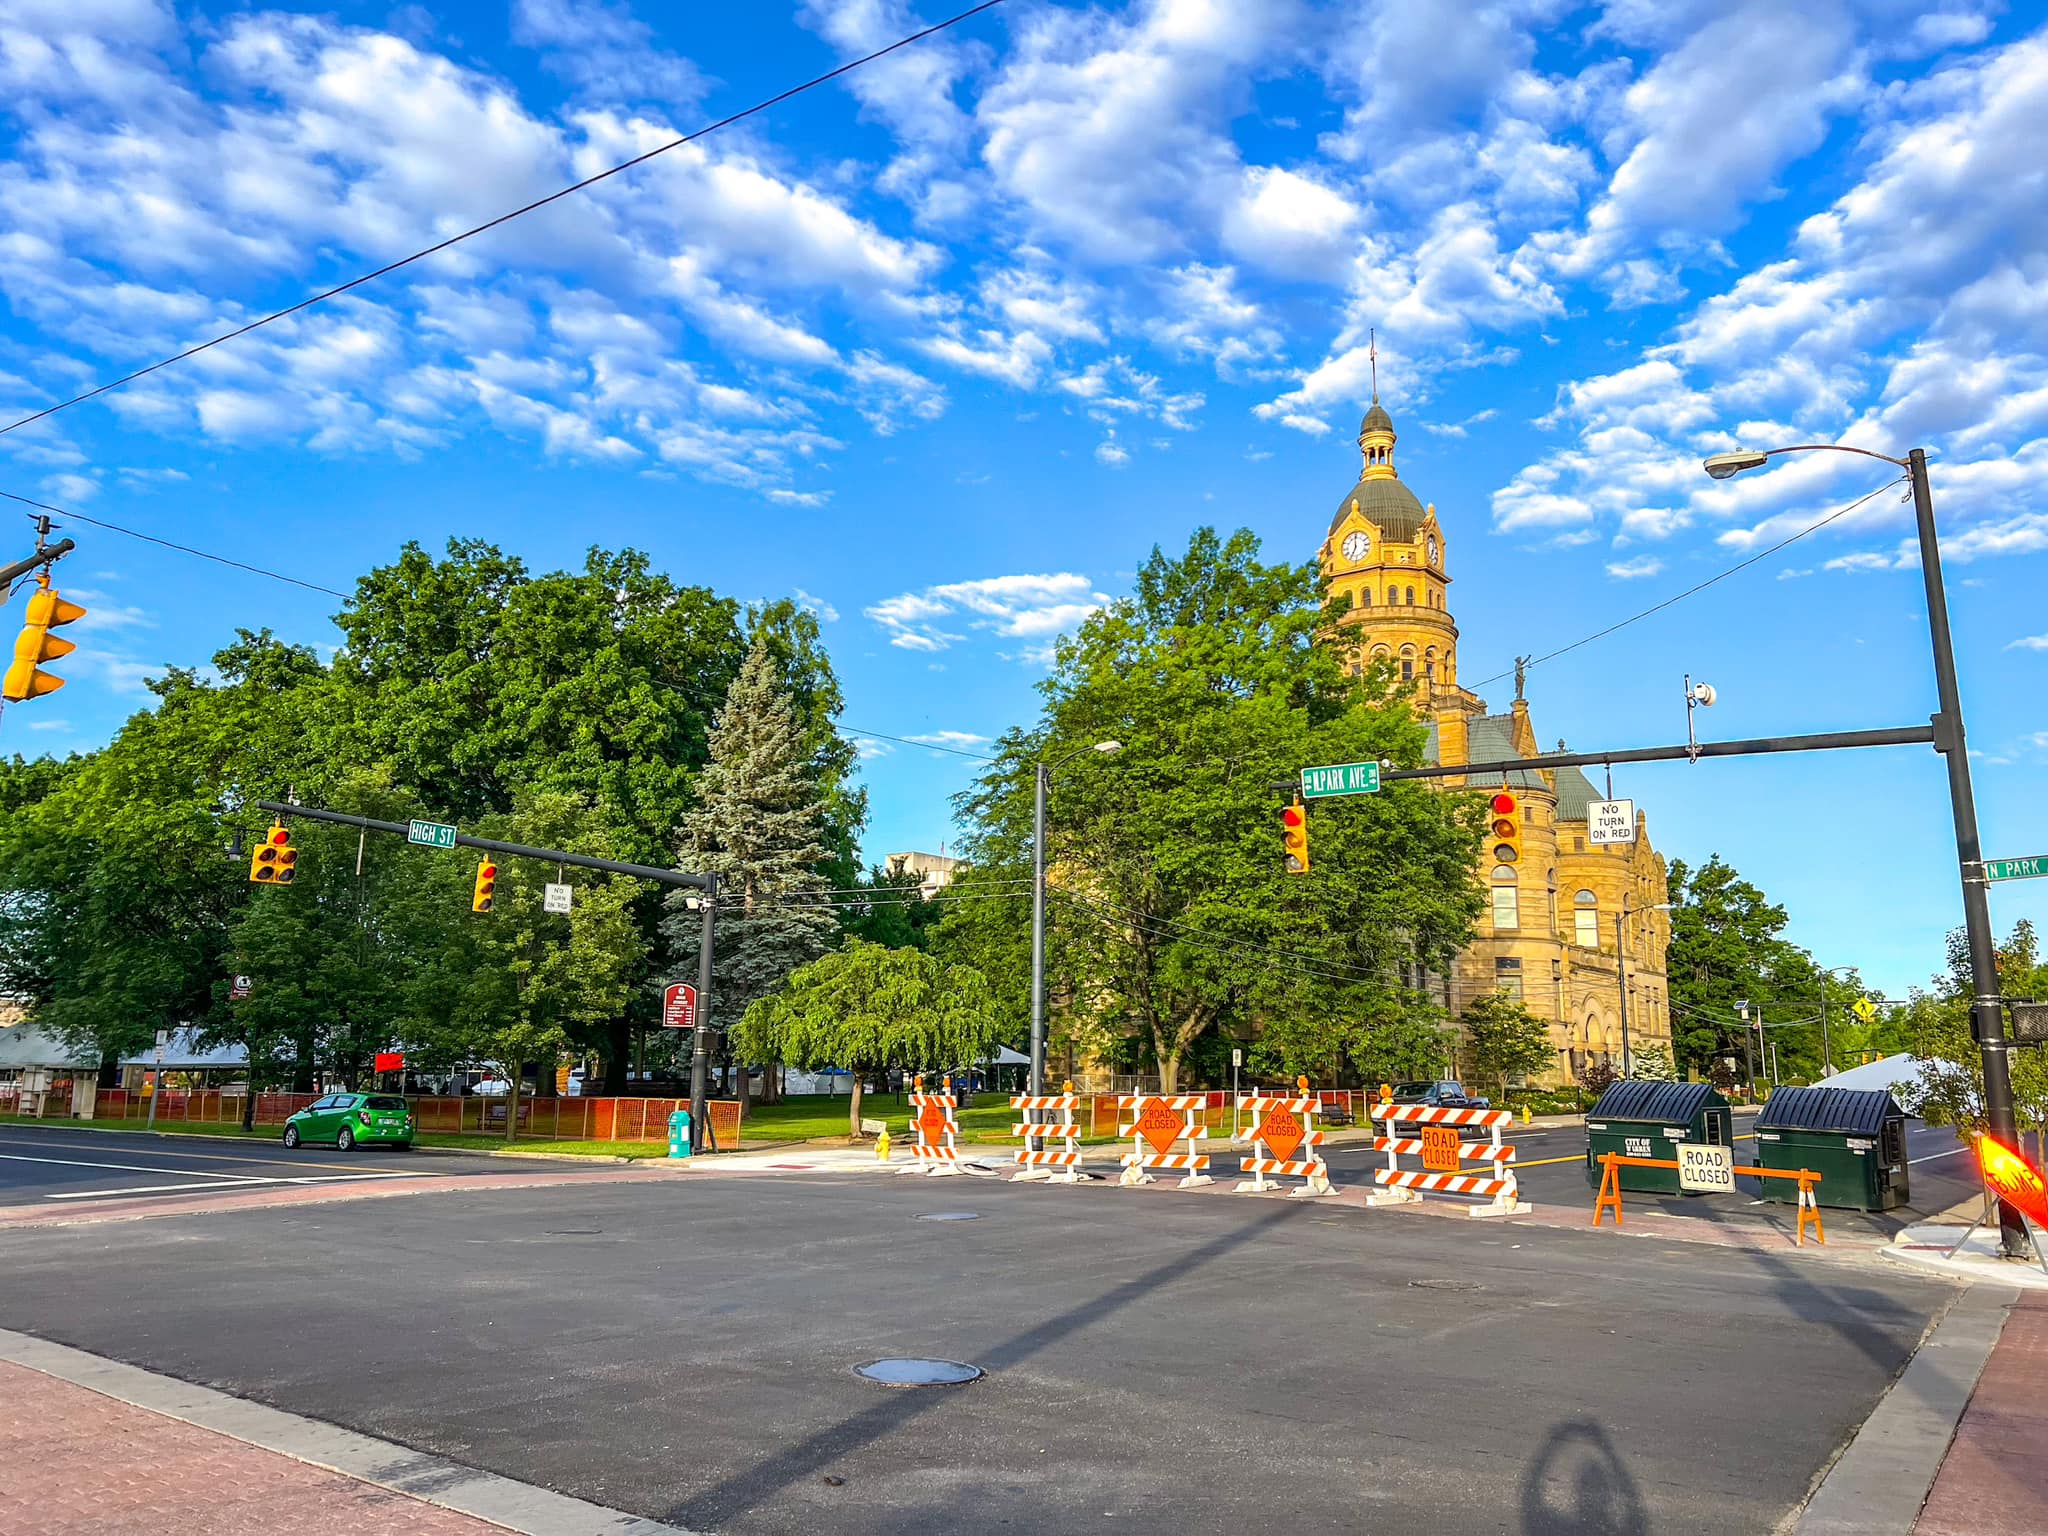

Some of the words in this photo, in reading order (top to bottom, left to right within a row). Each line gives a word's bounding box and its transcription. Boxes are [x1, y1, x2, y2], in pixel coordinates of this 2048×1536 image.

[1349, 766, 1369, 789] AVE.
[1602, 805, 1619, 815] NO
[1598, 817, 1625, 827] TURN
[411, 822, 437, 842] HIGH
[1593, 830, 1606, 840] ON
[1611, 828, 1631, 839] RED
[1989, 863, 1999, 877] N
[2005, 859, 2040, 876] PARK
[1149, 1109, 1171, 1119] ROAD
[1270, 1114, 1293, 1126] ROAD
[1144, 1119, 1176, 1130] CLOSED
[1266, 1125, 1297, 1137] CLOSED
[1424, 1131, 1456, 1148] ROAD
[1625, 1138, 1641, 1146] CITY
[1641, 1138, 1651, 1146] OF
[1424, 1148, 1457, 1166] CLOSED
[1686, 1151, 1723, 1167] ROAD
[1684, 1167, 1730, 1185] CLOSED
[1990, 1169, 2037, 1195] BUMP
